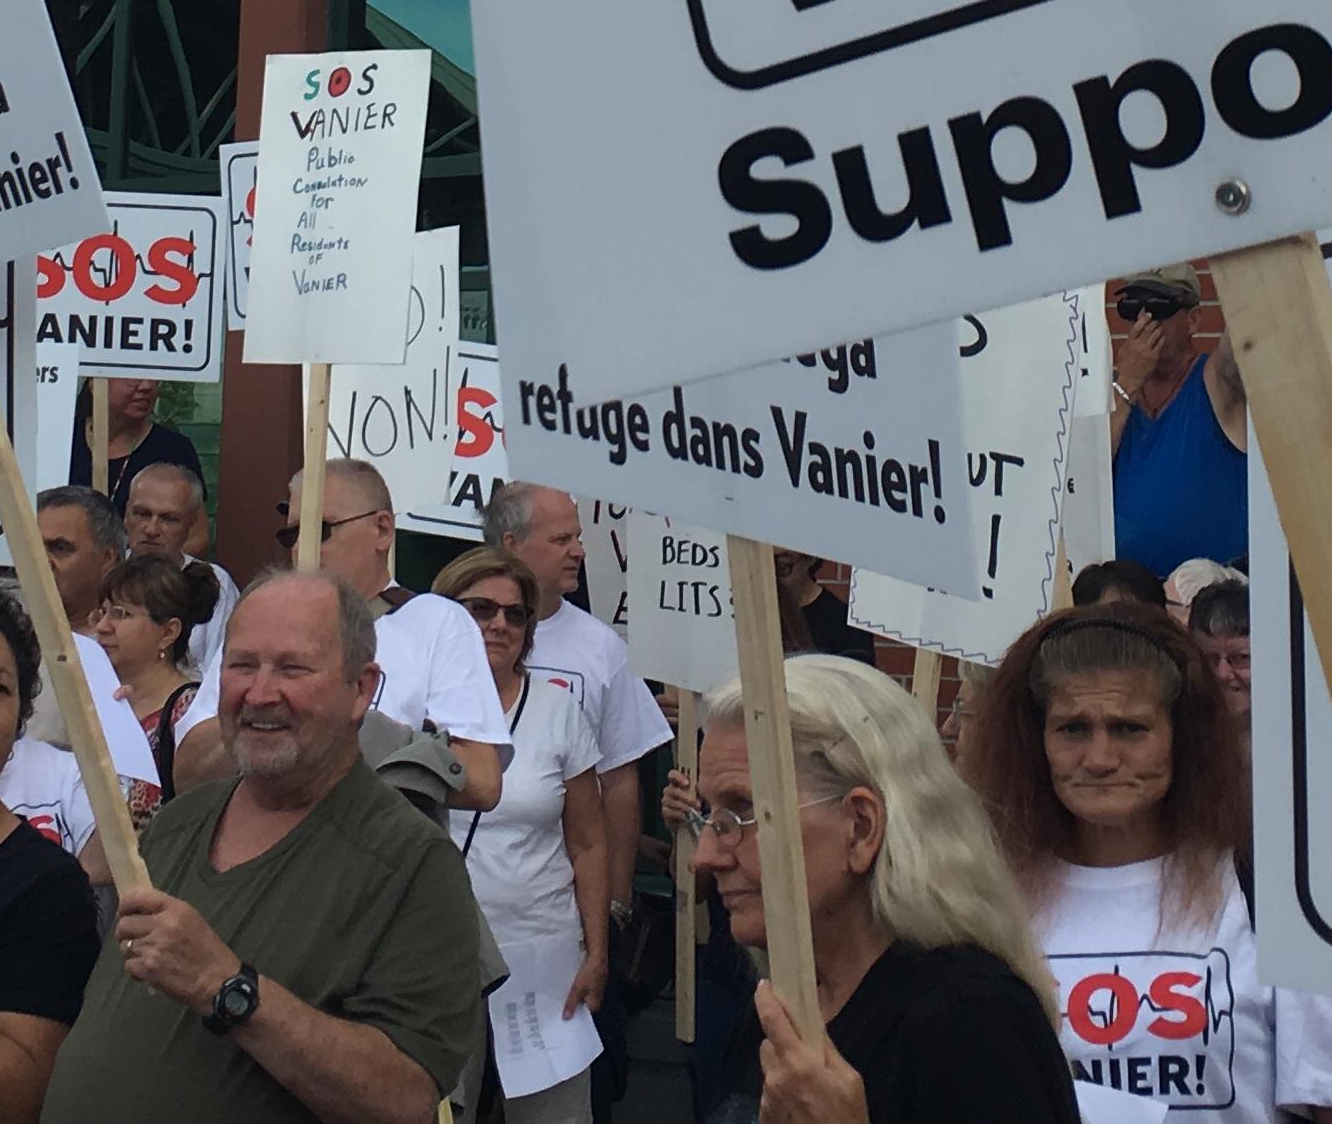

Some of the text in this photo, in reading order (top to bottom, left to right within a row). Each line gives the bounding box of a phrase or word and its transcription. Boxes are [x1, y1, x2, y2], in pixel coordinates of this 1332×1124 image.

[303, 63, 378, 101] SOS
[290, 102, 397, 142] VANIER
[37, 313, 194, 354] ANIER!
[518, 363, 650, 467] refuge
[662, 386, 765, 478] dans
[770, 405, 946, 525] Vanier!
[662, 536, 720, 568] BEDS
[1071, 1055, 1206, 1096] NIER!
